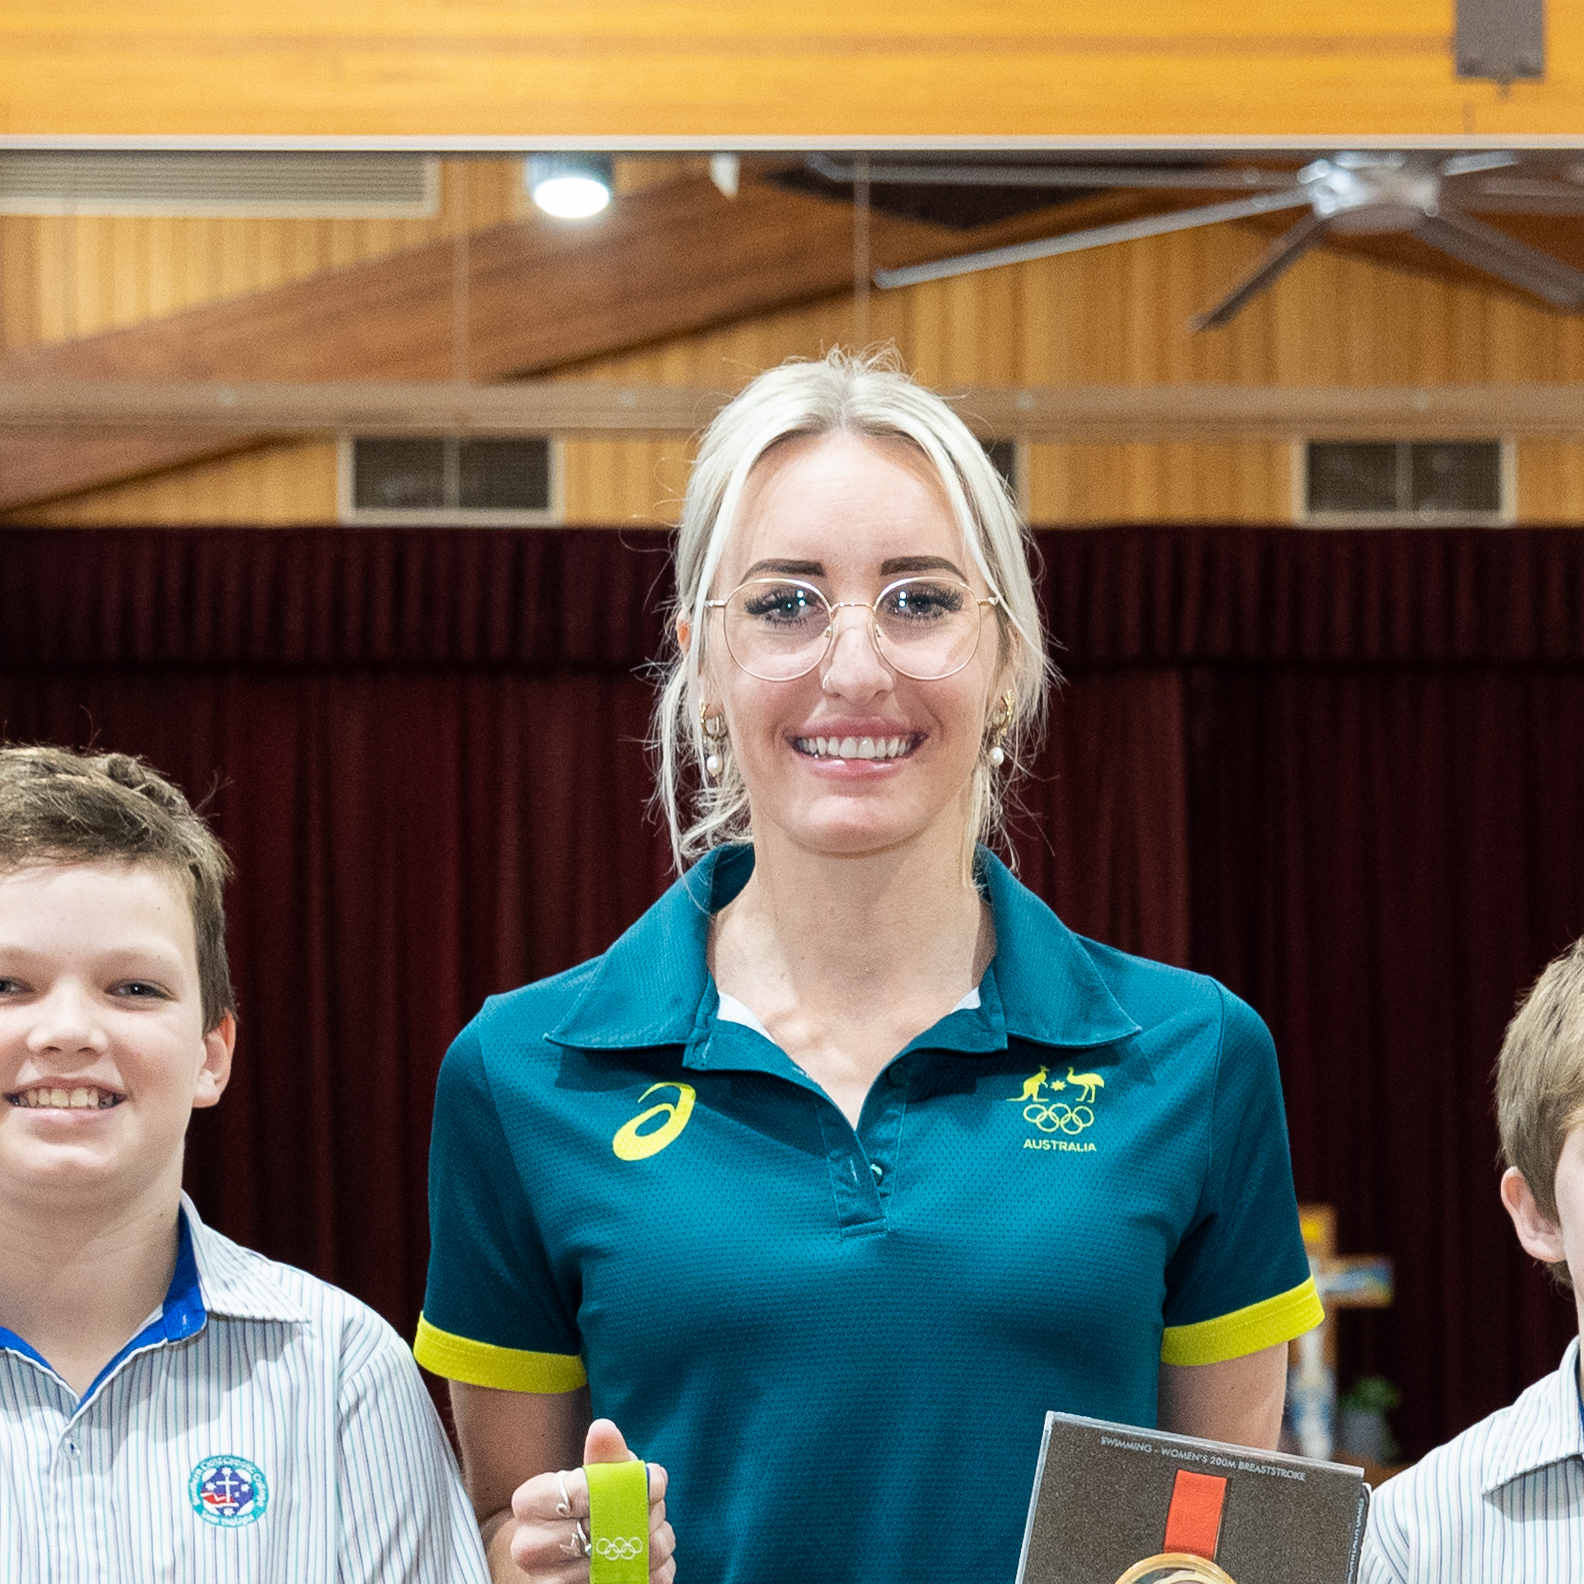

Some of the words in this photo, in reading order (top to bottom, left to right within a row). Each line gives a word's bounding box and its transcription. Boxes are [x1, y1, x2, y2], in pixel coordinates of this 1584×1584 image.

[1023, 1138, 1097, 1152] AUSTRALIA
[1100, 1436, 1153, 1454] SWIMMING
[1161, 1447, 1208, 1463] WOMEN'S
[1210, 1456, 1236, 1469] 200M
[1238, 1461, 1306, 1481] BREASTSTROKE
